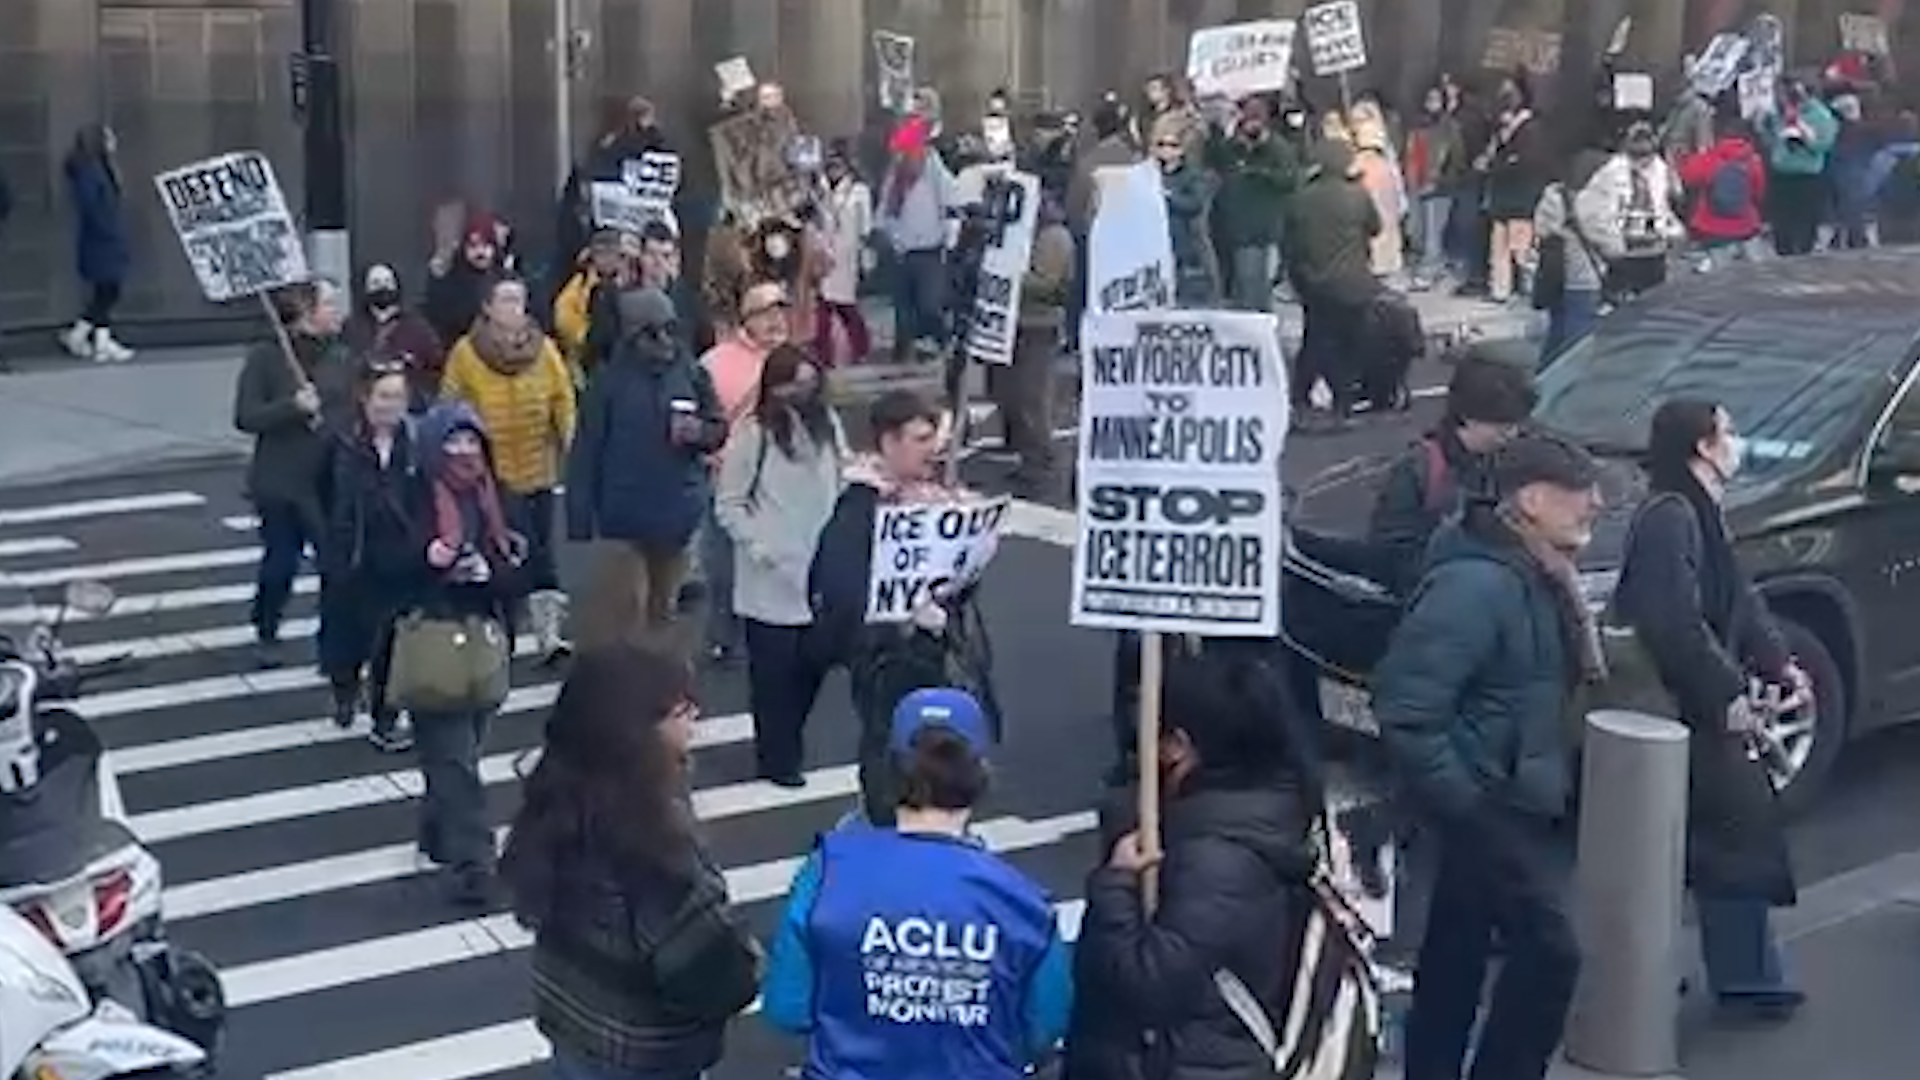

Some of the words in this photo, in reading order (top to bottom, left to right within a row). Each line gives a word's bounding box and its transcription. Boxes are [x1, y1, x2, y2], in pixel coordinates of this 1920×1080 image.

[165, 157, 267, 209] DEFEND
[1094, 346, 1136, 384] NEW
[1141, 345, 1203, 385] YORK
[1210, 345, 1262, 387] CITY
[1146, 392, 1190, 412] TO
[1091, 416, 1263, 463] MINNEAPOLIS
[881, 509, 927, 540] ICE
[1087, 486, 1267, 525] STOP
[894, 547, 930, 572] OF
[1087, 529, 1127, 580] ICE
[1134, 530, 1262, 588] TERROR
[860, 916, 998, 961] ACLU
[864, 972, 992, 1004] PROTEST
